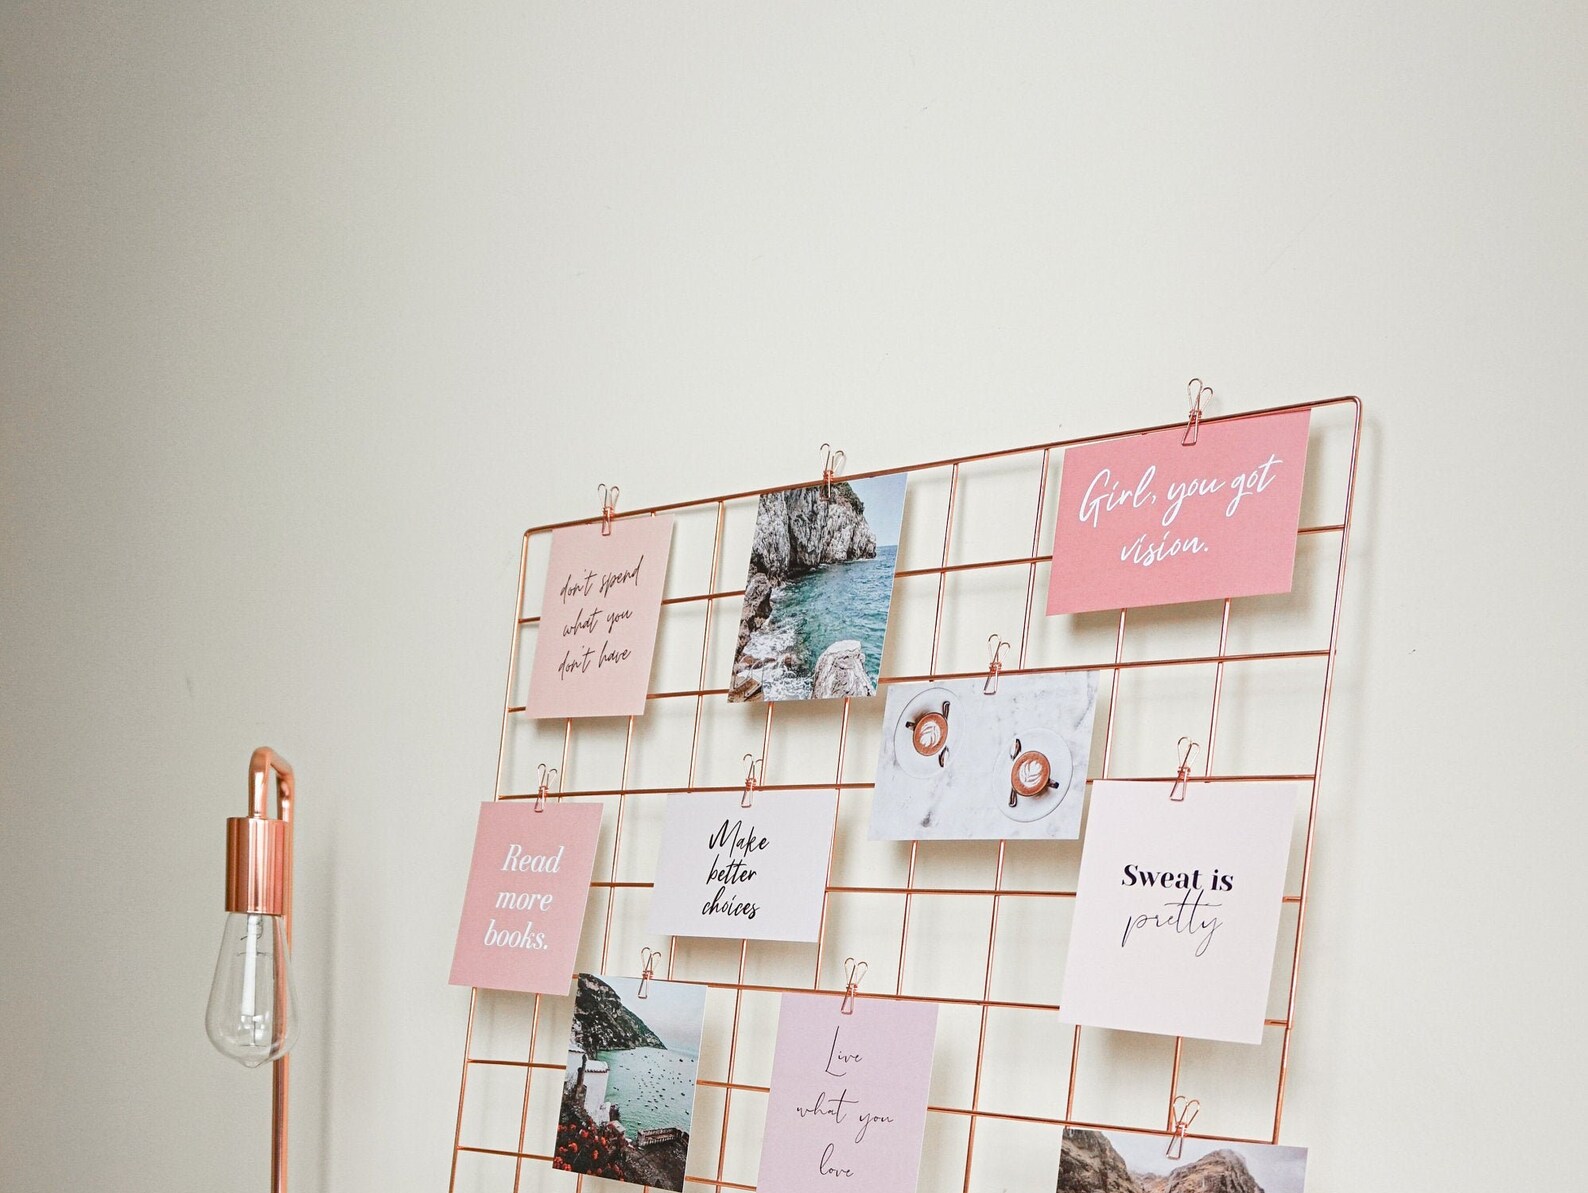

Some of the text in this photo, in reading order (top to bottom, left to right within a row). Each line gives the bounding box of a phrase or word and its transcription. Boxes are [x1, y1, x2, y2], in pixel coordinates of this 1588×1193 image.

[1078, 453, 1284, 528] Girl, you got
[1120, 530, 1210, 567] vision.
[559, 554, 644, 604] don't spend
[562, 607, 634, 637] what you
[557, 640, 632, 681] don't have
[708, 818, 770, 858] Make
[500, 843, 565, 874] Read
[705, 853, 757, 885] better
[1121, 863, 1234, 892] Sweat is
[495, 890, 554, 912] more
[701, 885, 761, 920] choices
[483, 918, 549, 951] books.
[1121, 887, 1224, 958] pretty
[825, 1025, 863, 1077] Live
[796, 1088, 895, 1145] what you
[819, 1143, 854, 1178] love
